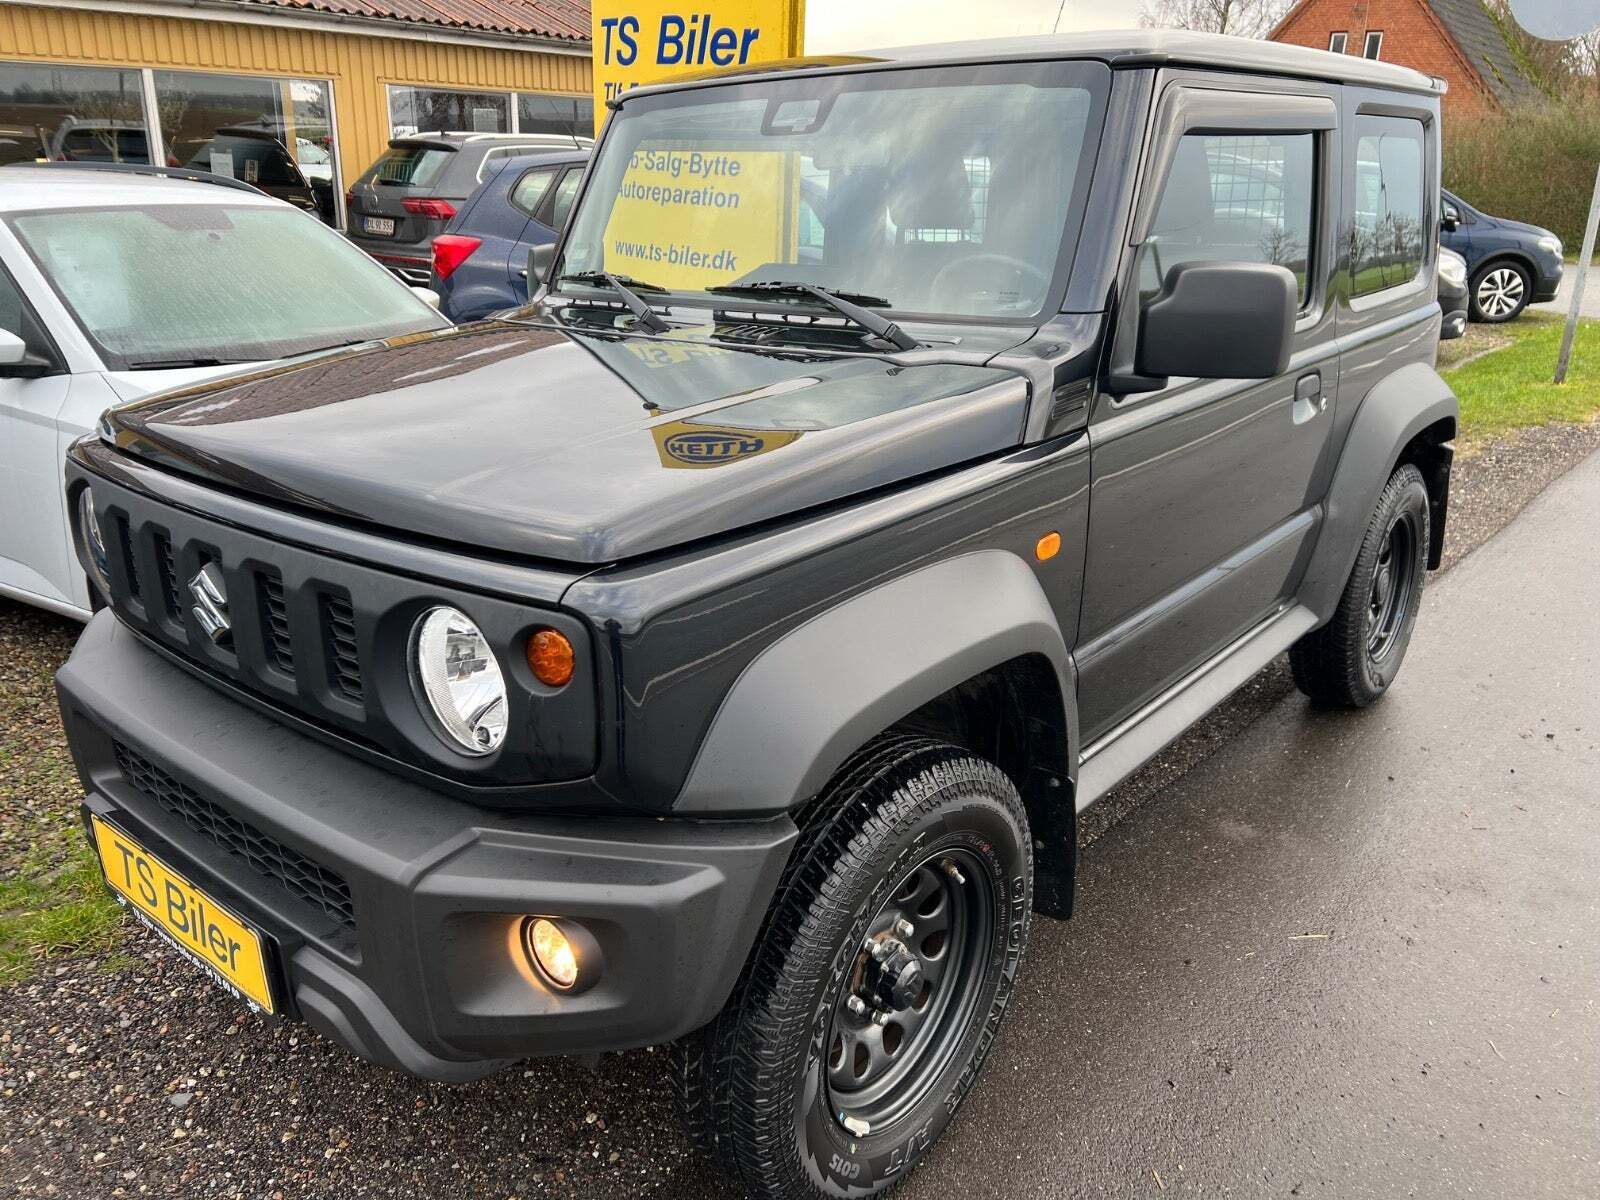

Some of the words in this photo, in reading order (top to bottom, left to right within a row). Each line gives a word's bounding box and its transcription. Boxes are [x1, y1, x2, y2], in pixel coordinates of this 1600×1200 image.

[601, 16, 640, 66] TS
[656, 14, 760, 66] Biler
[629, 150, 741, 178] b-Salg-Bytte
[615, 239, 739, 271] www.ts-biler.dk
[114, 839, 158, 908] TS
[165, 878, 241, 972] Biler
[828, 1153, 861, 1179] G015
[884, 1118, 933, 1177] A/T
